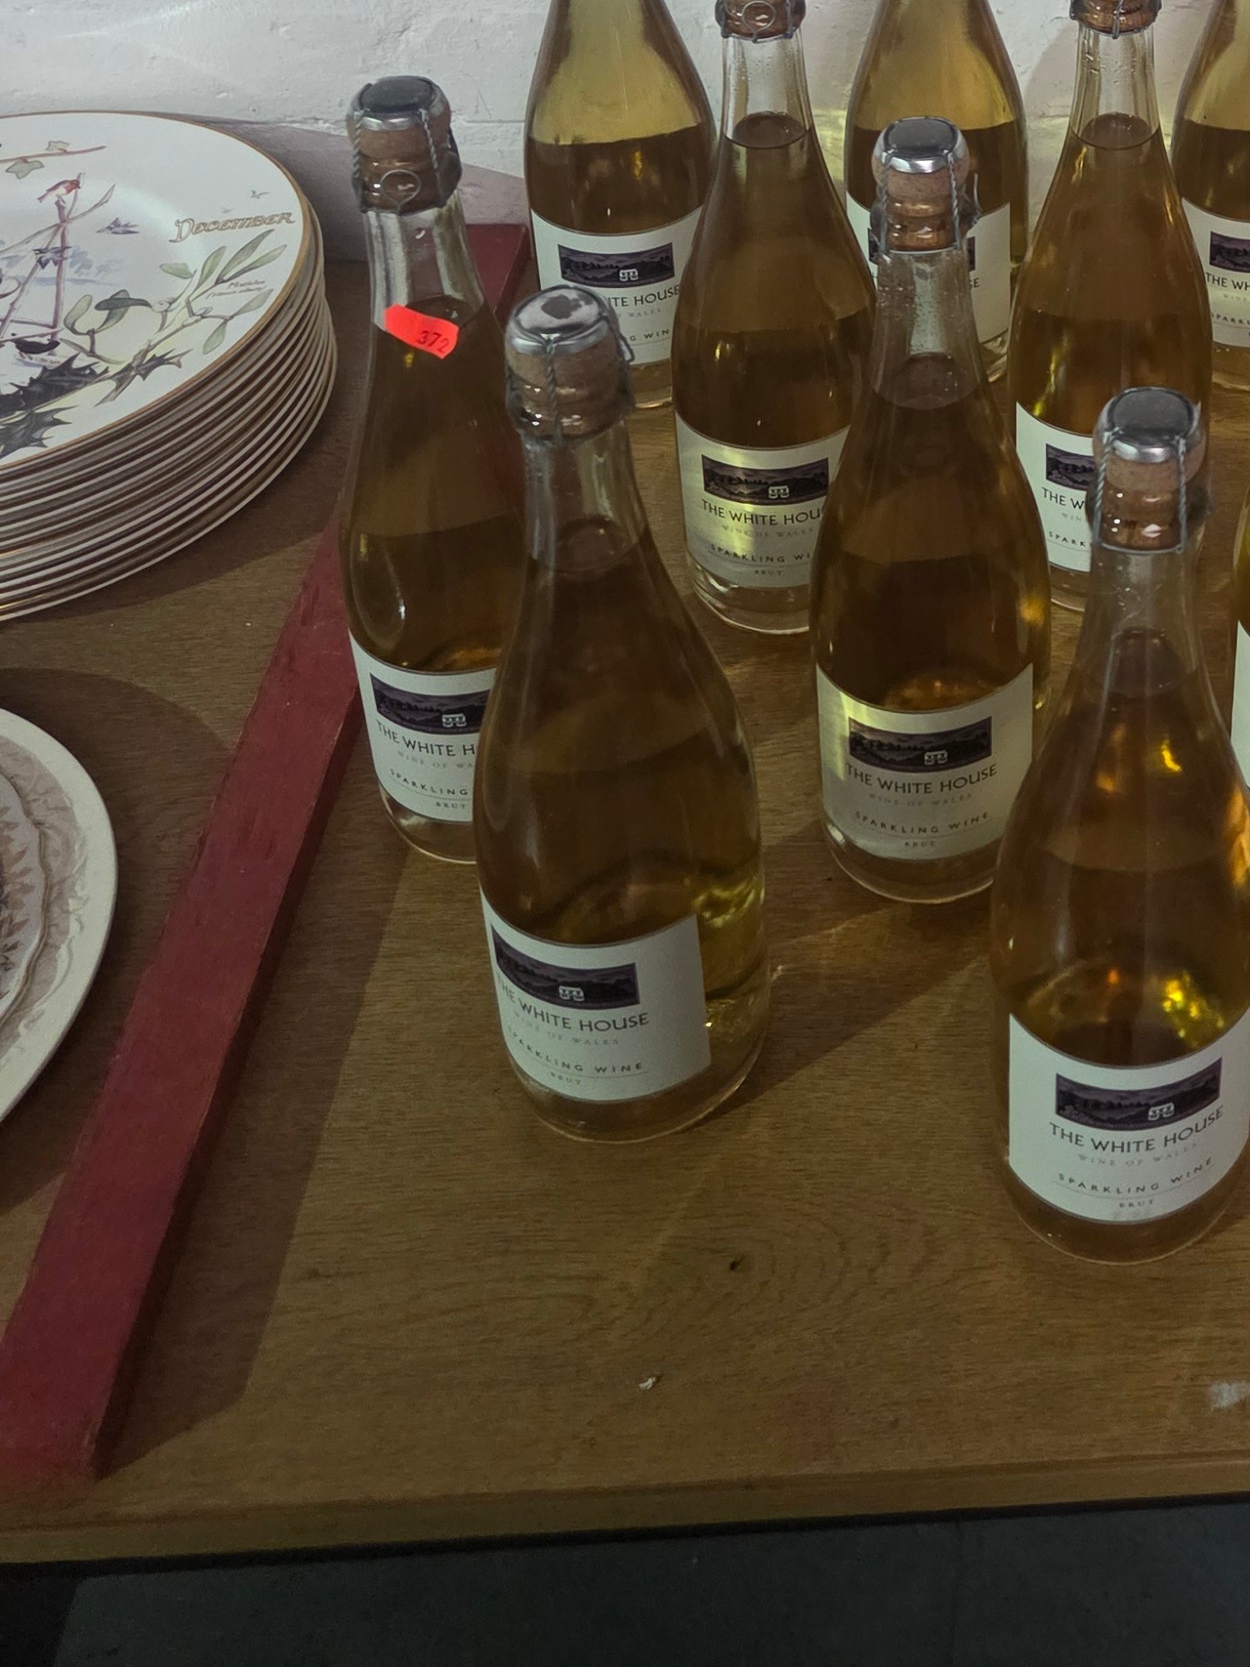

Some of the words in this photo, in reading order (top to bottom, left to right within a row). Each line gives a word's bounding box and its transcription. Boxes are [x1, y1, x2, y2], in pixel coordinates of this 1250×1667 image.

[1206, 272, 1228, 288] THE
[634, 286, 680, 306] HOUSE
[416, 330, 449, 354] 372
[1042, 486, 1066, 506] THE
[701, 498, 726, 519] THE
[728, 510, 778, 526] WHITE
[710, 543, 786, 564] SPARKLING
[376, 719, 400, 744] THE
[402, 735, 456, 758] WHITE
[390, 768, 469, 796] SPARKLING
[846, 762, 872, 786] THE
[877, 777, 934, 794] WHITE
[940, 763, 998, 792] HOUSE
[855, 810, 940, 834] SPARKLING
[948, 812, 990, 831] WINE
[518, 998, 572, 1030] WHITE
[579, 1012, 650, 1033] HOUSE
[594, 1062, 644, 1074] WINE
[1049, 1121, 1085, 1148] THE
[1090, 1137, 1156, 1154] WHITE
[1163, 1104, 1225, 1150] HOUSE
[1058, 1173, 1160, 1194] SPARKLING
[1170, 1157, 1214, 1184] WINE
[1119, 1200, 1155, 1208] BRUT
